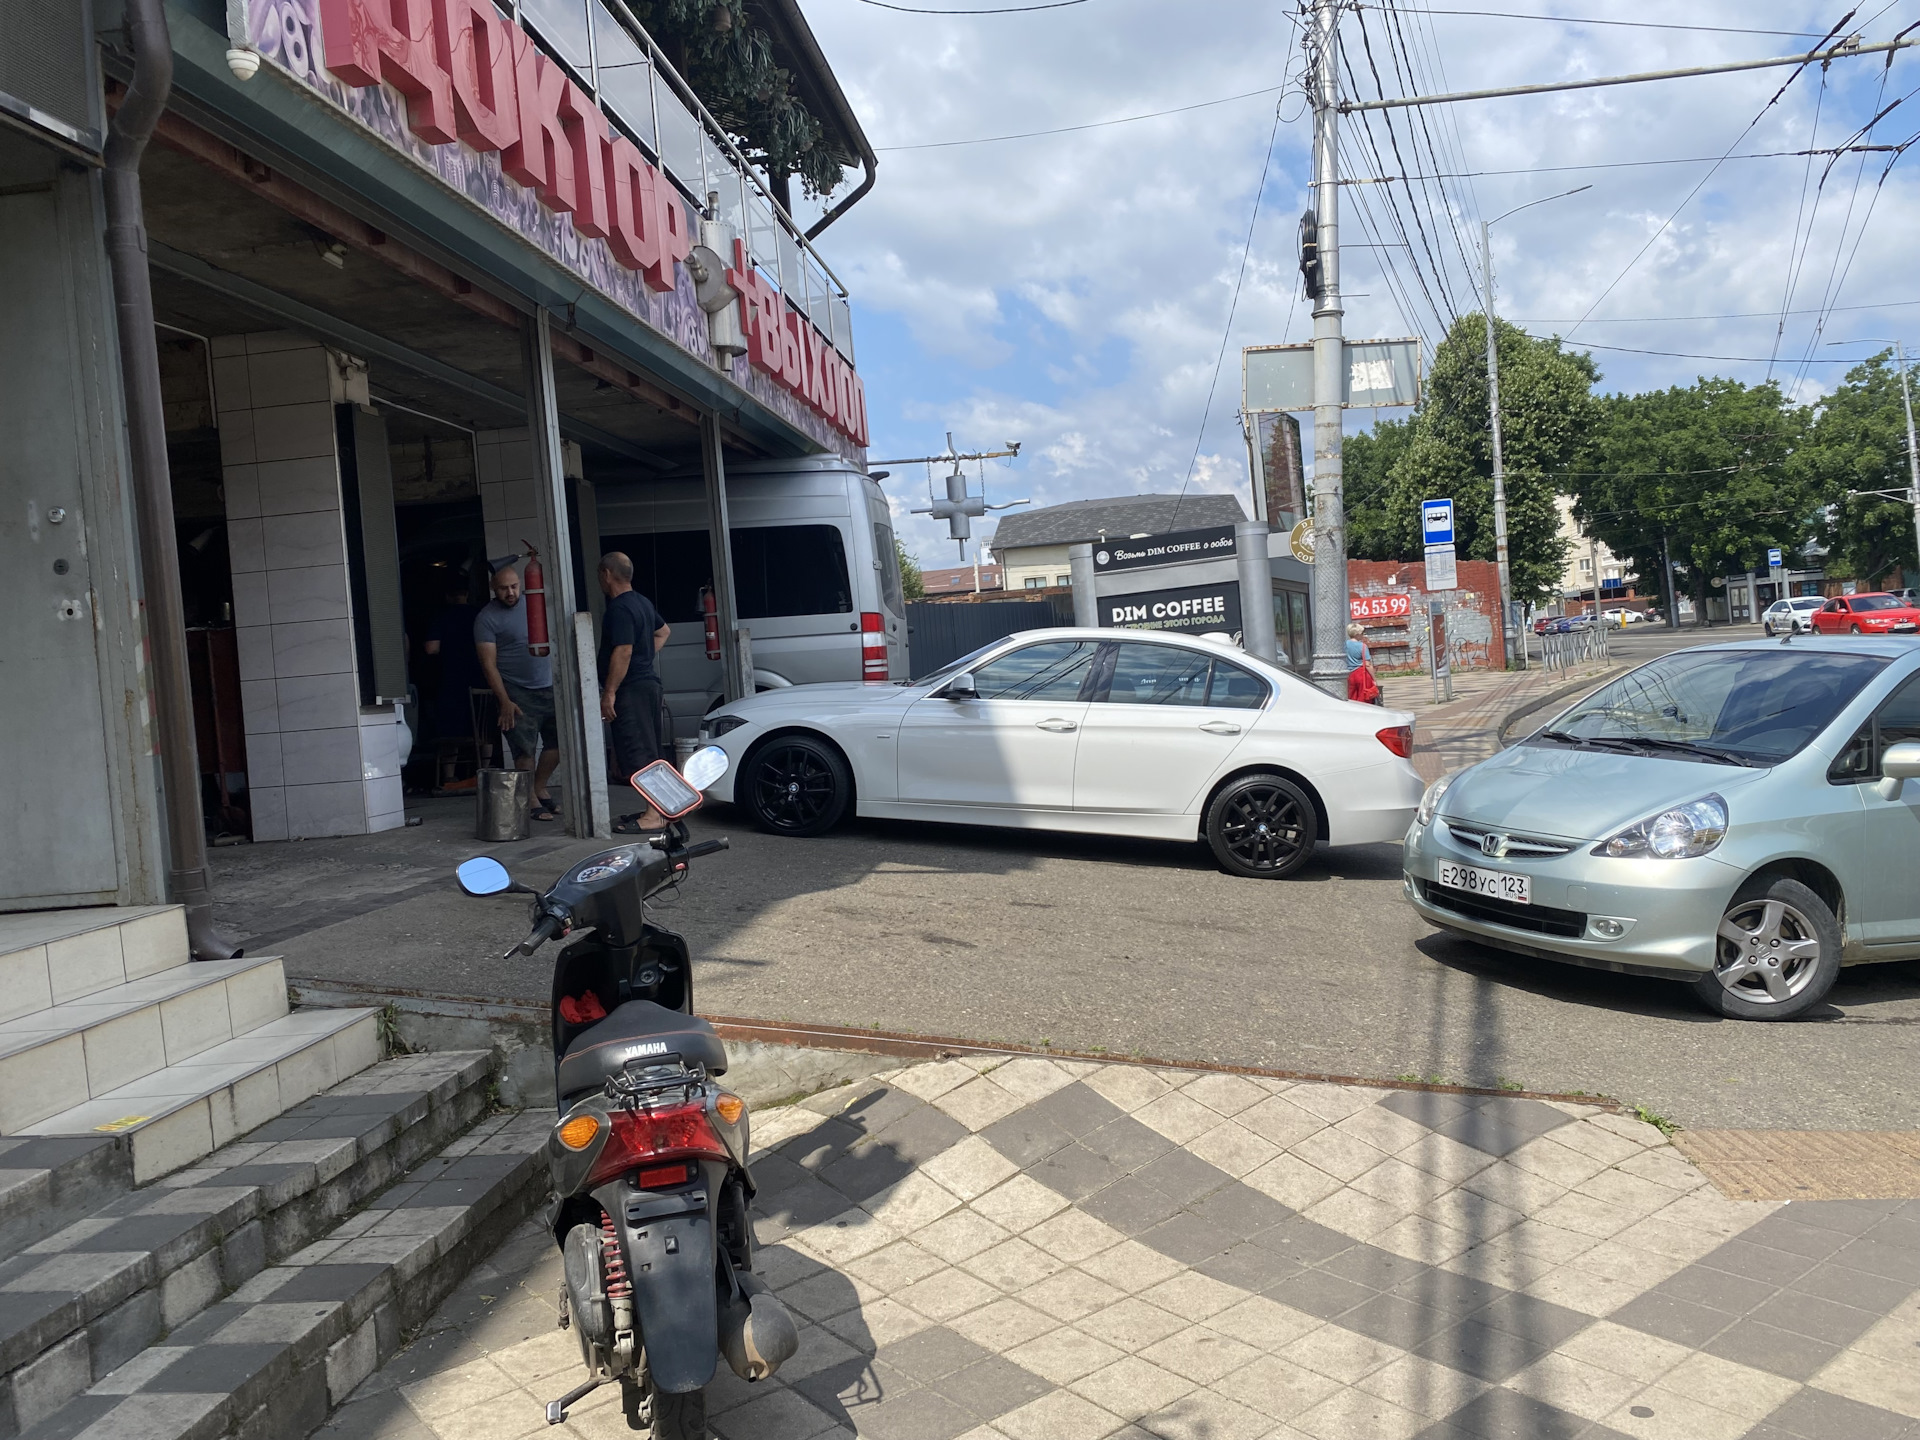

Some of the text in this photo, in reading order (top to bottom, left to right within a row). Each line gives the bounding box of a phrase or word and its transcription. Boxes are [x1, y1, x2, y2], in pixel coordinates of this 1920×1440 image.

[1147, 546, 1165, 556] DIM
[1166, 542, 1201, 553] COFFEE
[1112, 596, 1225, 622] DIM COFFEE
[1371, 599, 1388, 615] 53
[1390, 597, 1408, 614] 99
[1163, 617, 1190, 628] ЭТОГО
[1191, 614, 1225, 625] ГОРОДА
[1442, 866, 1524, 894] Е298УС 123
[1505, 891, 1518, 900] RUS
[625, 1042, 667, 1057] YAMAHA
